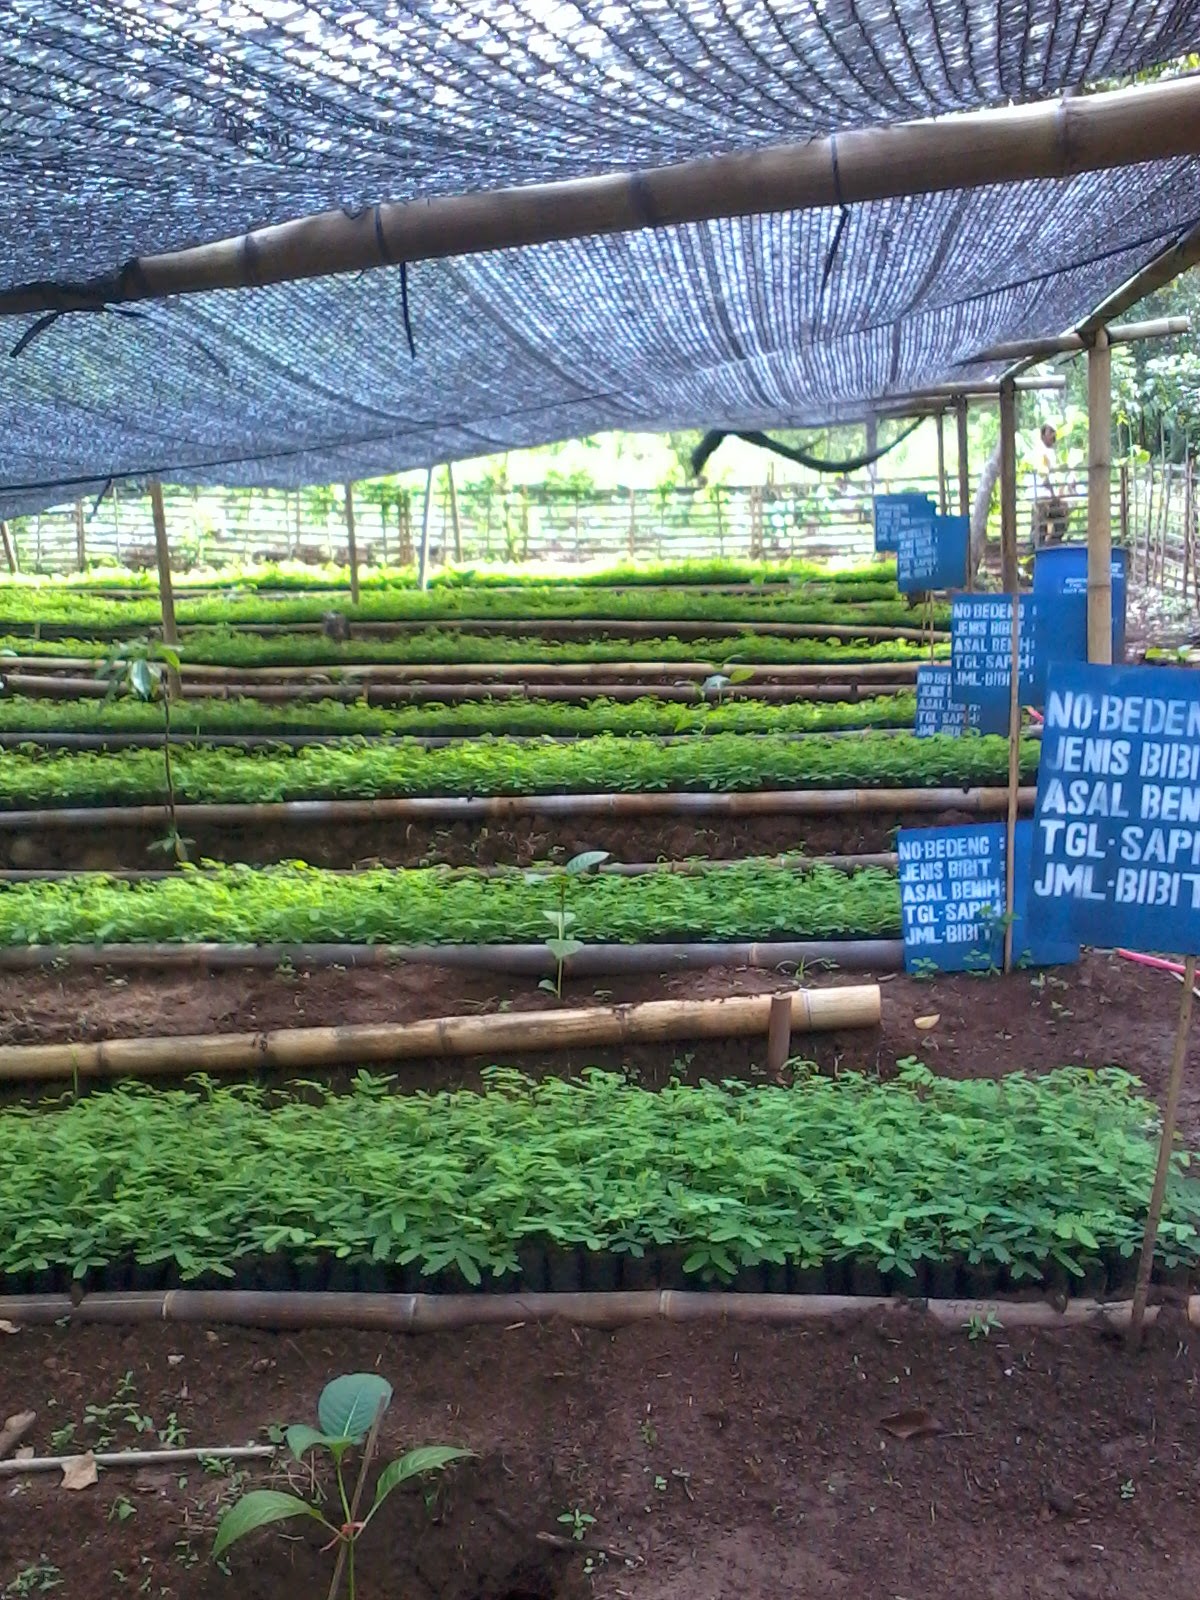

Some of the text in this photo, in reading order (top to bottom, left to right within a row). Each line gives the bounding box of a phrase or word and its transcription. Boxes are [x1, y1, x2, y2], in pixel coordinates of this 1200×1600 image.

[954, 637, 988, 653] ASAL
[1046, 735, 1200, 781] JENIS BIBI
[1041, 778, 1200, 823] ASAL BEN
[901, 858, 992, 882] JENIS BIBIT
[903, 877, 1000, 903] ASAL BENIH
